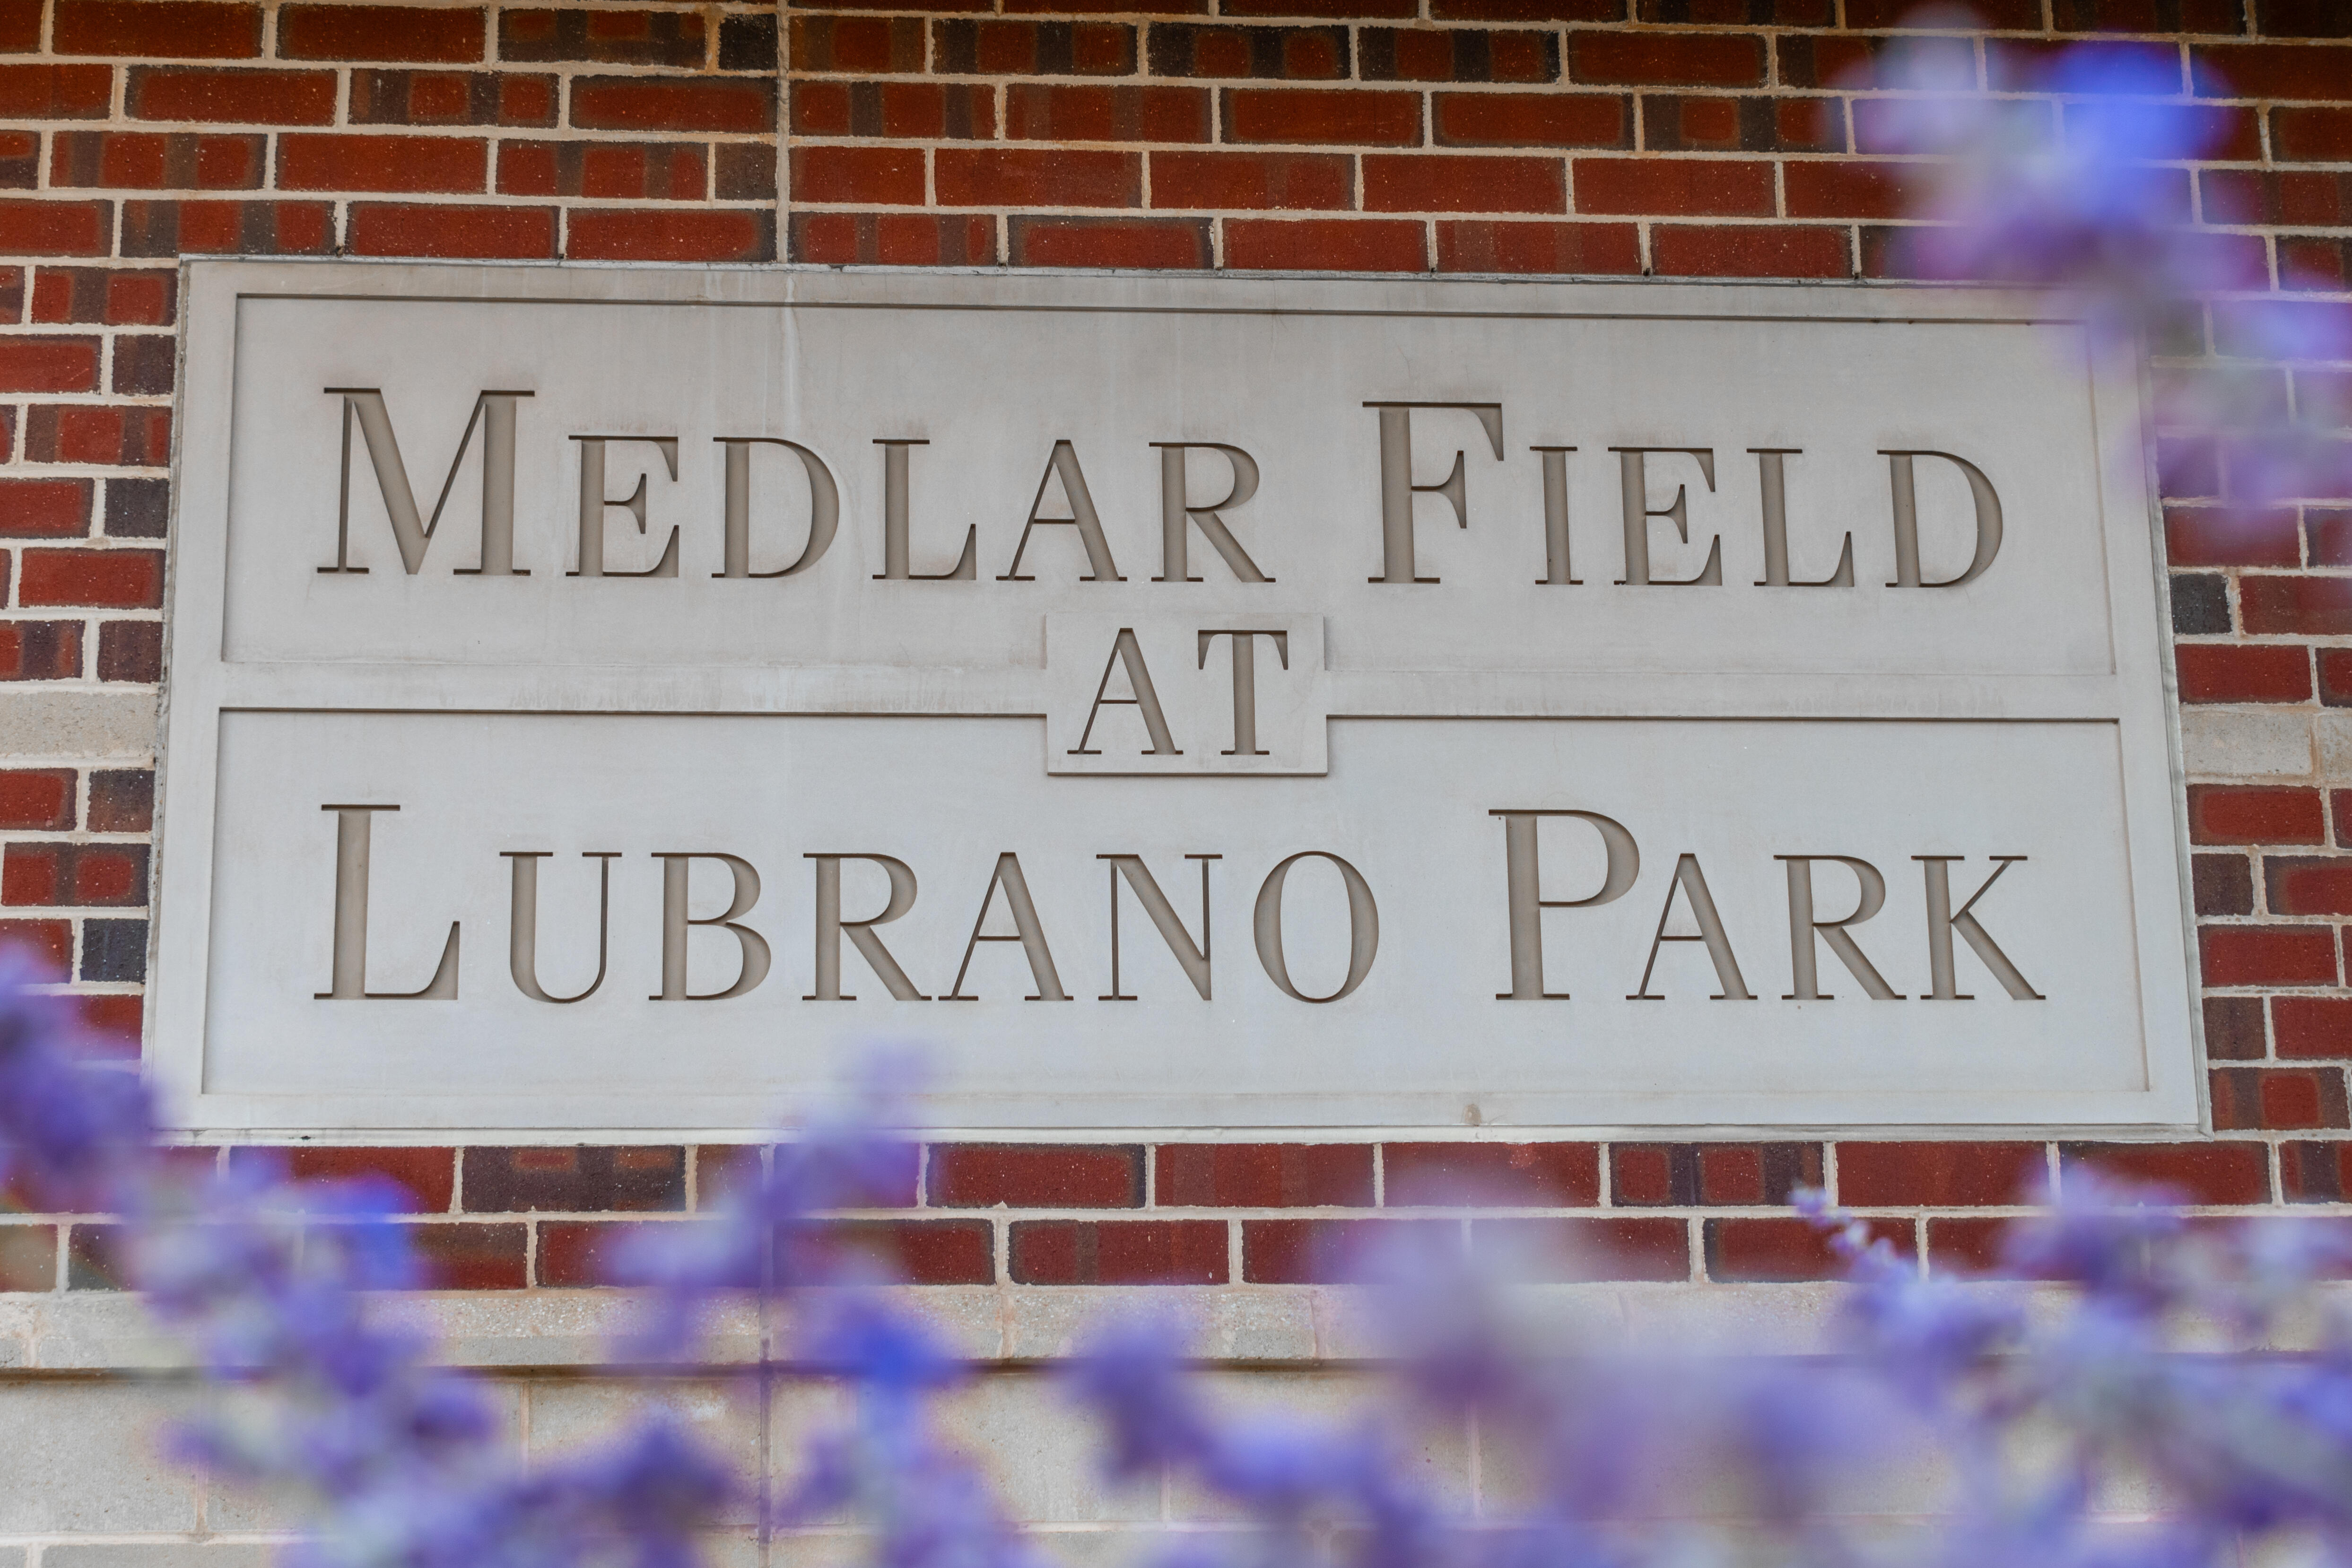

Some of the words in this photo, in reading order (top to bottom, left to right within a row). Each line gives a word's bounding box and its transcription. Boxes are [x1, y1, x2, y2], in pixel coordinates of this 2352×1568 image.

[316, 386, 1277, 584] MEDLAR
[1361, 400, 2004, 589] FIELD
[1066, 627, 1289, 756] AT
[314, 803, 1380, 1005] LUBRANO
[1488, 808, 2047, 1002] PARK
